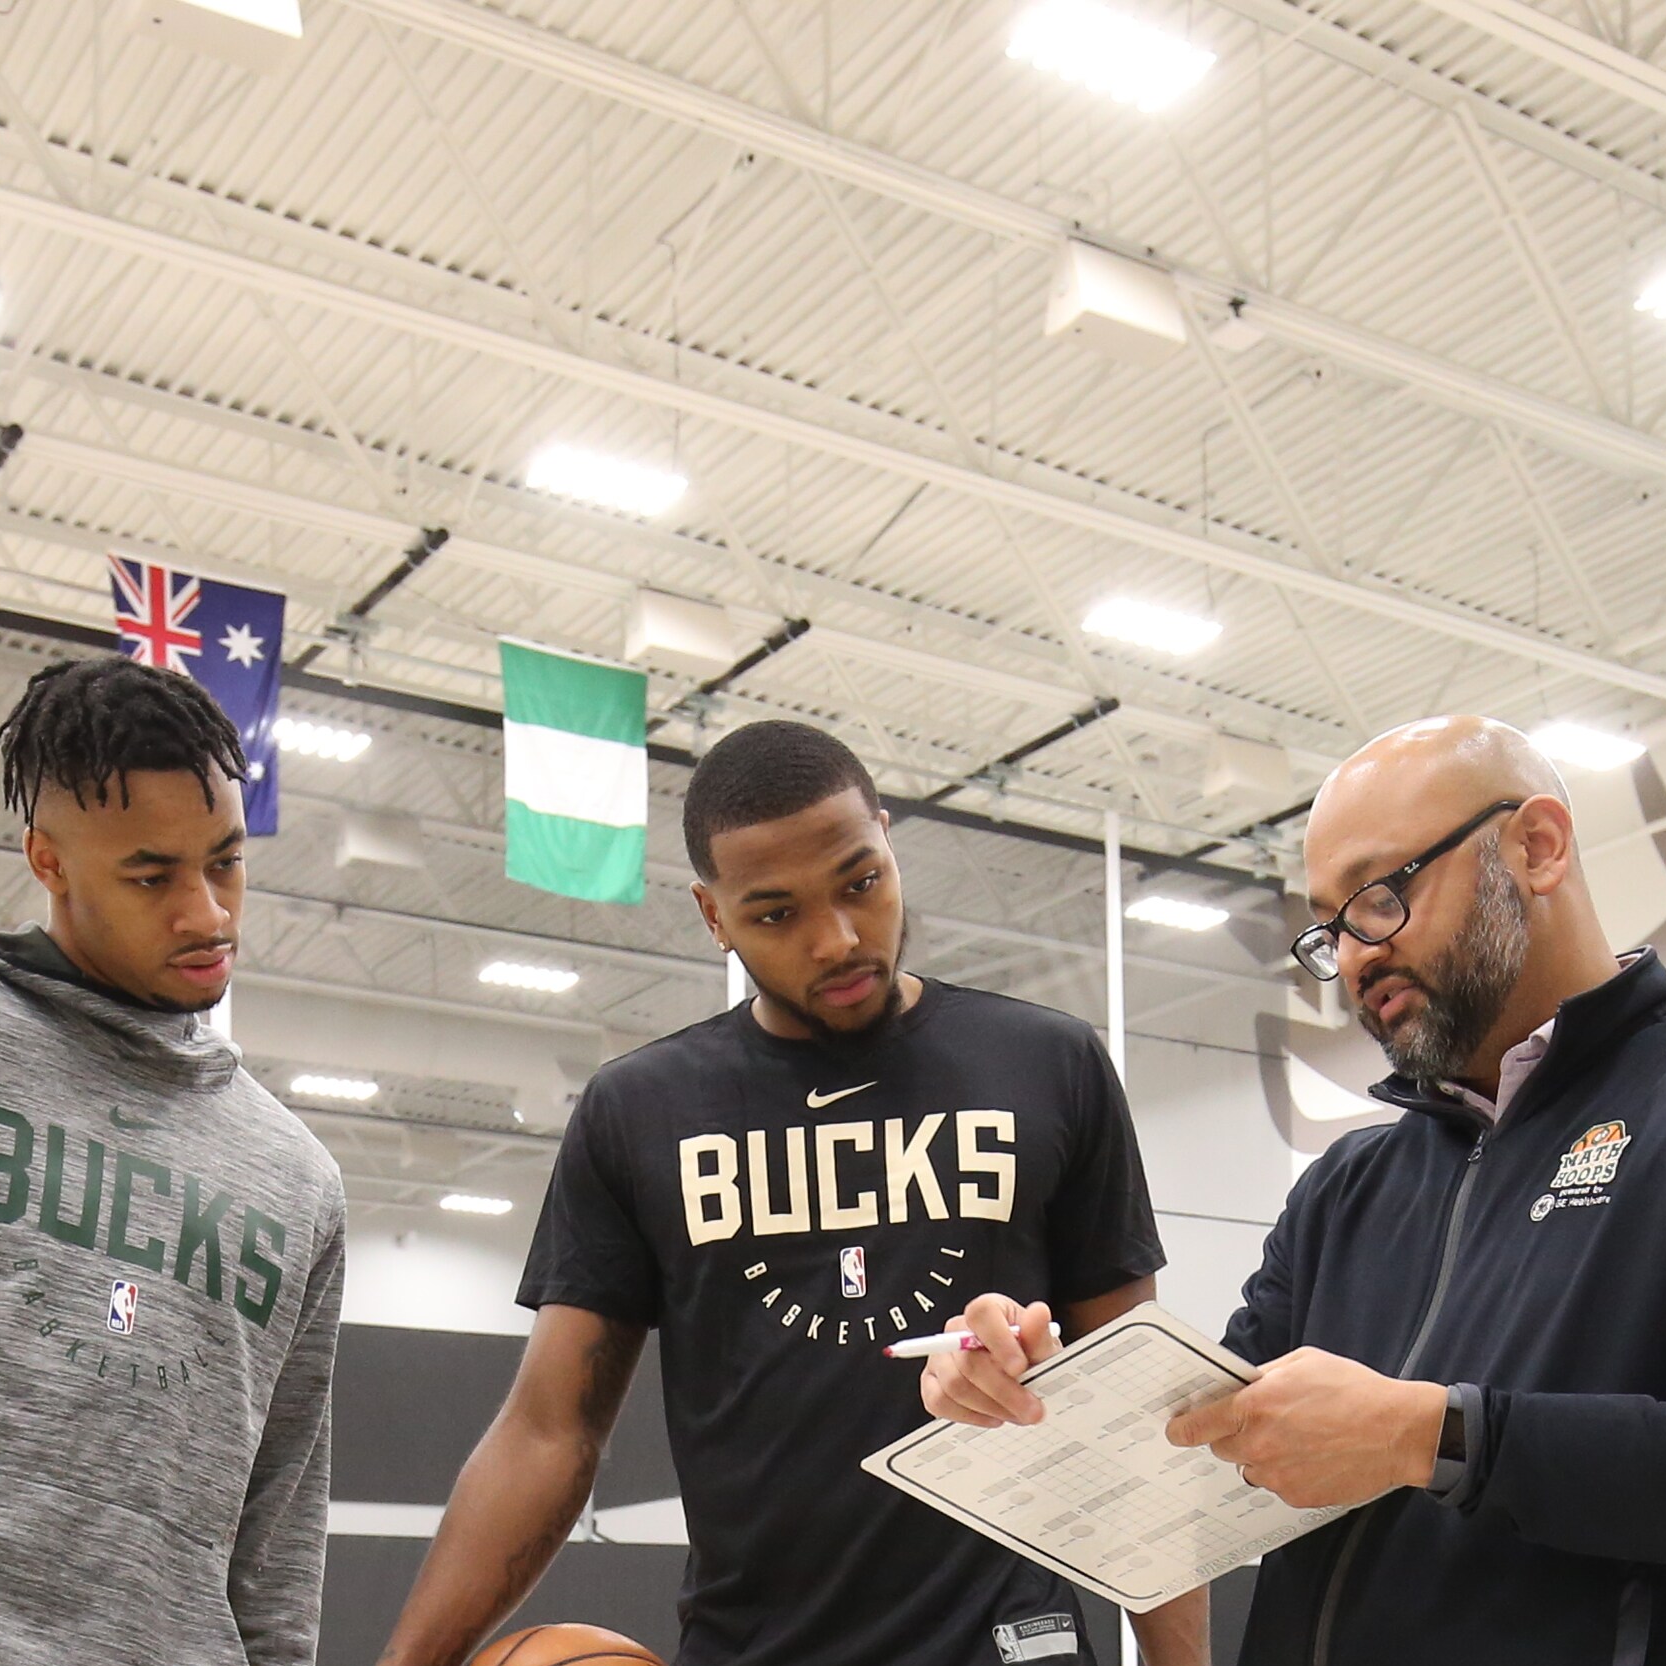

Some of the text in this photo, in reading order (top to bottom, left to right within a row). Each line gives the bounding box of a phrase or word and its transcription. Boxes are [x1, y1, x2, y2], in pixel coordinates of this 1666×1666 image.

[679, 1109, 1016, 1247] BUCKS
[1554, 1162, 1616, 1187] HOOPS
[1562, 1140, 1627, 1169] MATH
[744, 1247, 965, 1345] BASKETBALL
